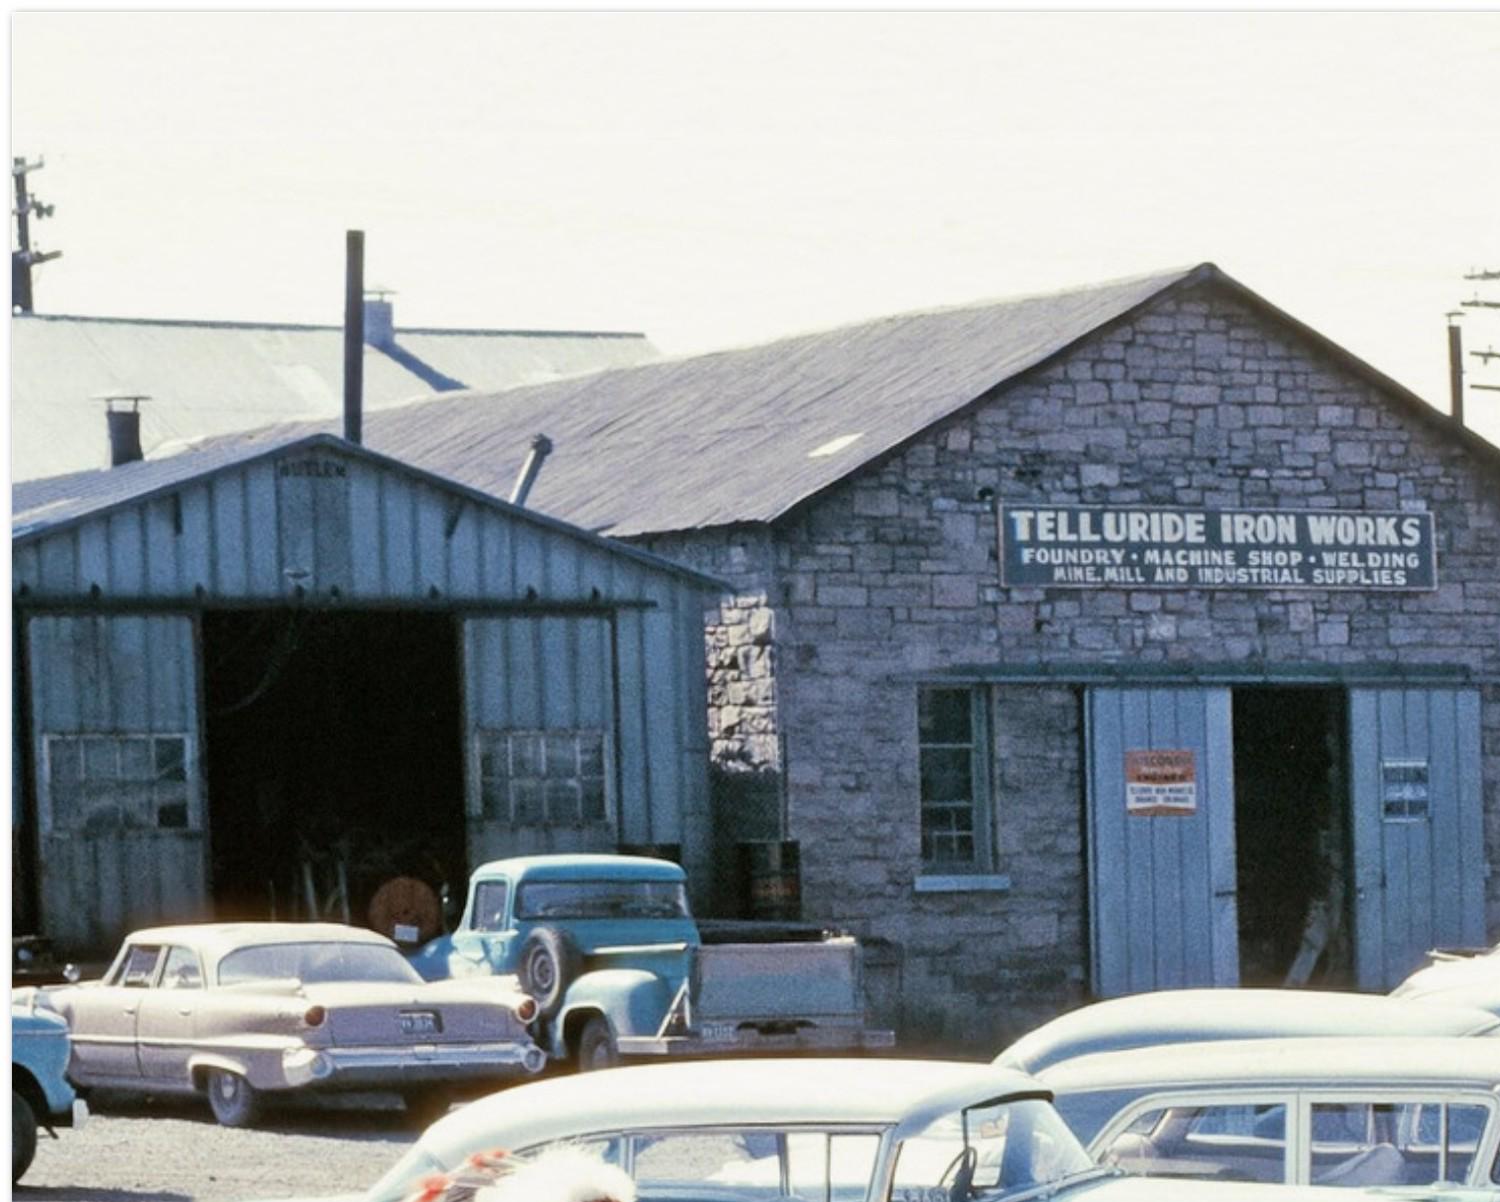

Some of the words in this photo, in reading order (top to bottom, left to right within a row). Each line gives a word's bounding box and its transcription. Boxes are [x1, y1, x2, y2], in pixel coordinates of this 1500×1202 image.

[1009, 511, 1206, 543] TELLURIDE
[1220, 513, 1297, 544] IRON
[1306, 515, 1421, 546] WORKS
[1021, 548, 1126, 564] FOUNDRY
[1144, 550, 1236, 566] MACHINE
[1248, 551, 1303, 566] SHOP
[1321, 552, 1420, 568] WELDING
[1154, 568, 1189, 582] AND
[1198, 568, 1305, 584] INDUSTRIAL
[1312, 570, 1407, 585] SUPPLIES
